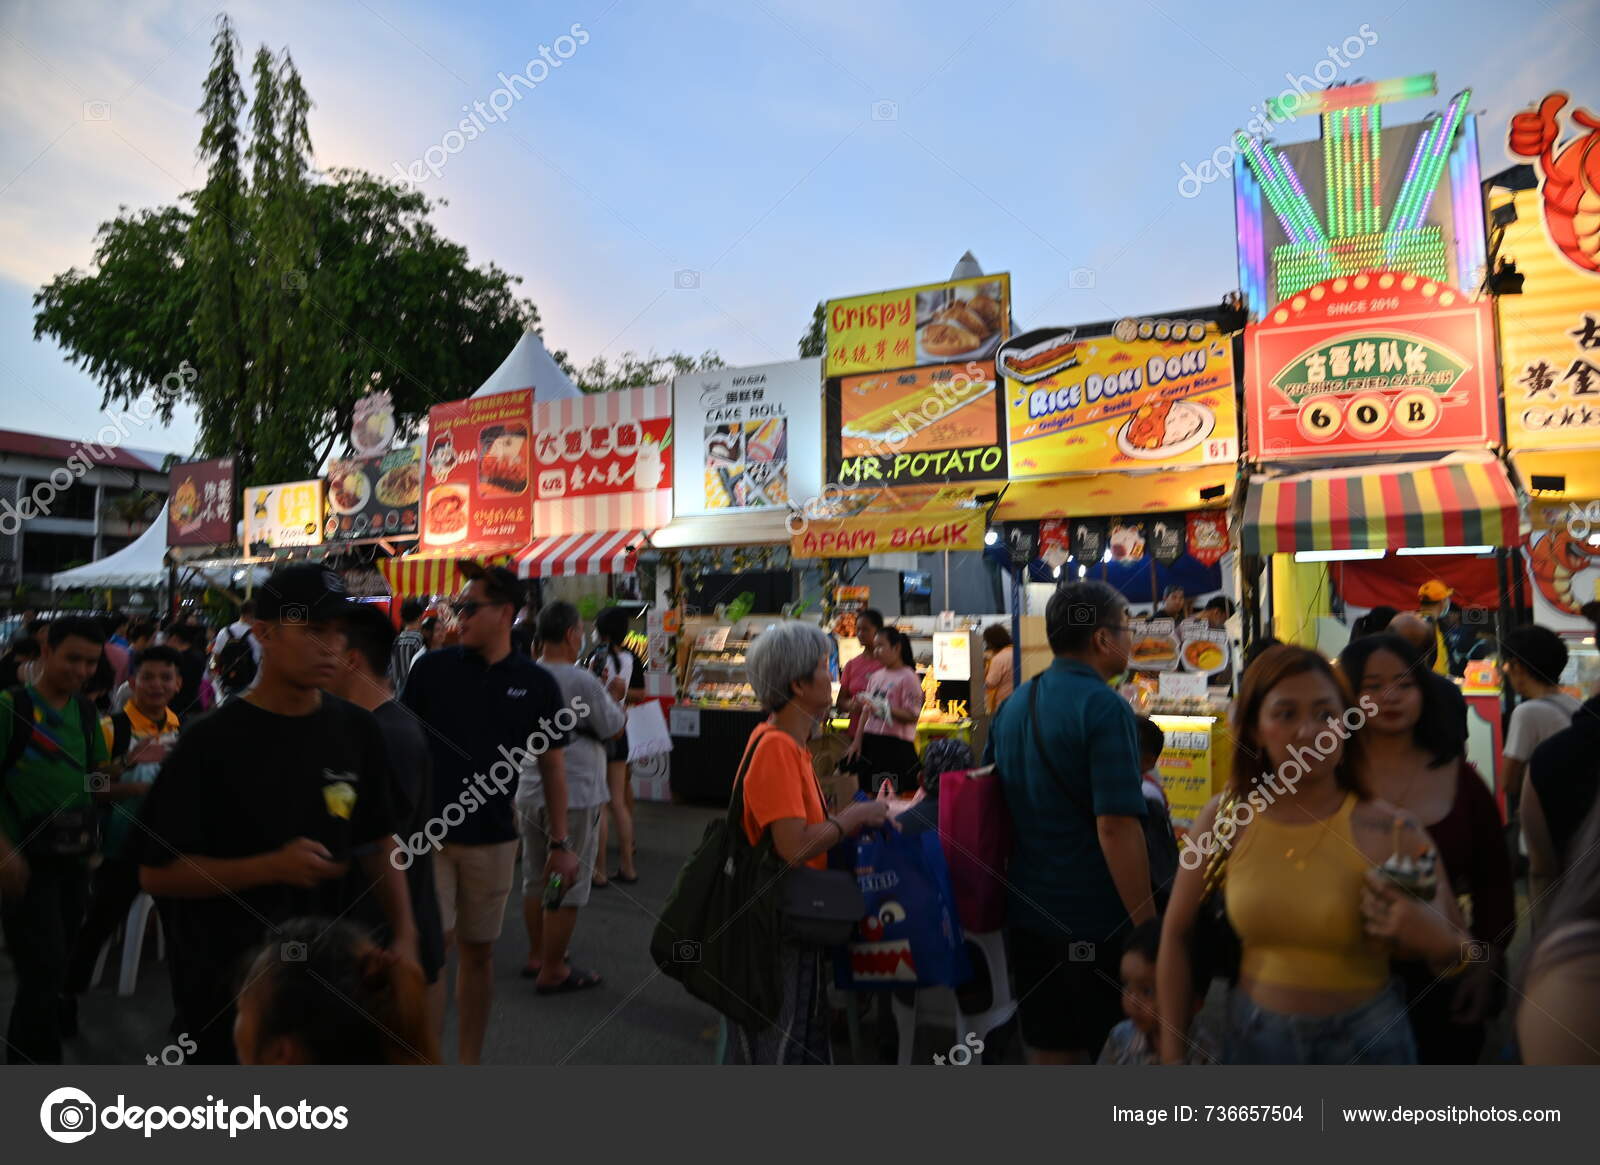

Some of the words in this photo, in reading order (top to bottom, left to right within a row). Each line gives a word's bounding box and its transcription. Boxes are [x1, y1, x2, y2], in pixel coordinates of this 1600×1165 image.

[832, 297, 911, 333] Crispy
[1327, 300, 1367, 316] SINCE
[1028, 385, 1081, 418] RICE
[1085, 365, 1143, 403] DOKI
[1146, 347, 1207, 386] DOKI
[1161, 383, 1191, 398] Curry
[1194, 376, 1218, 388] Rice
[1346, 376, 1389, 389] FRIED
[706, 407, 741, 422] CAKE
[750, 400, 787, 417] ROLL
[1208, 443, 1228, 457] 61
[803, 529, 877, 552] APAM
[889, 523, 969, 548] BALIK
